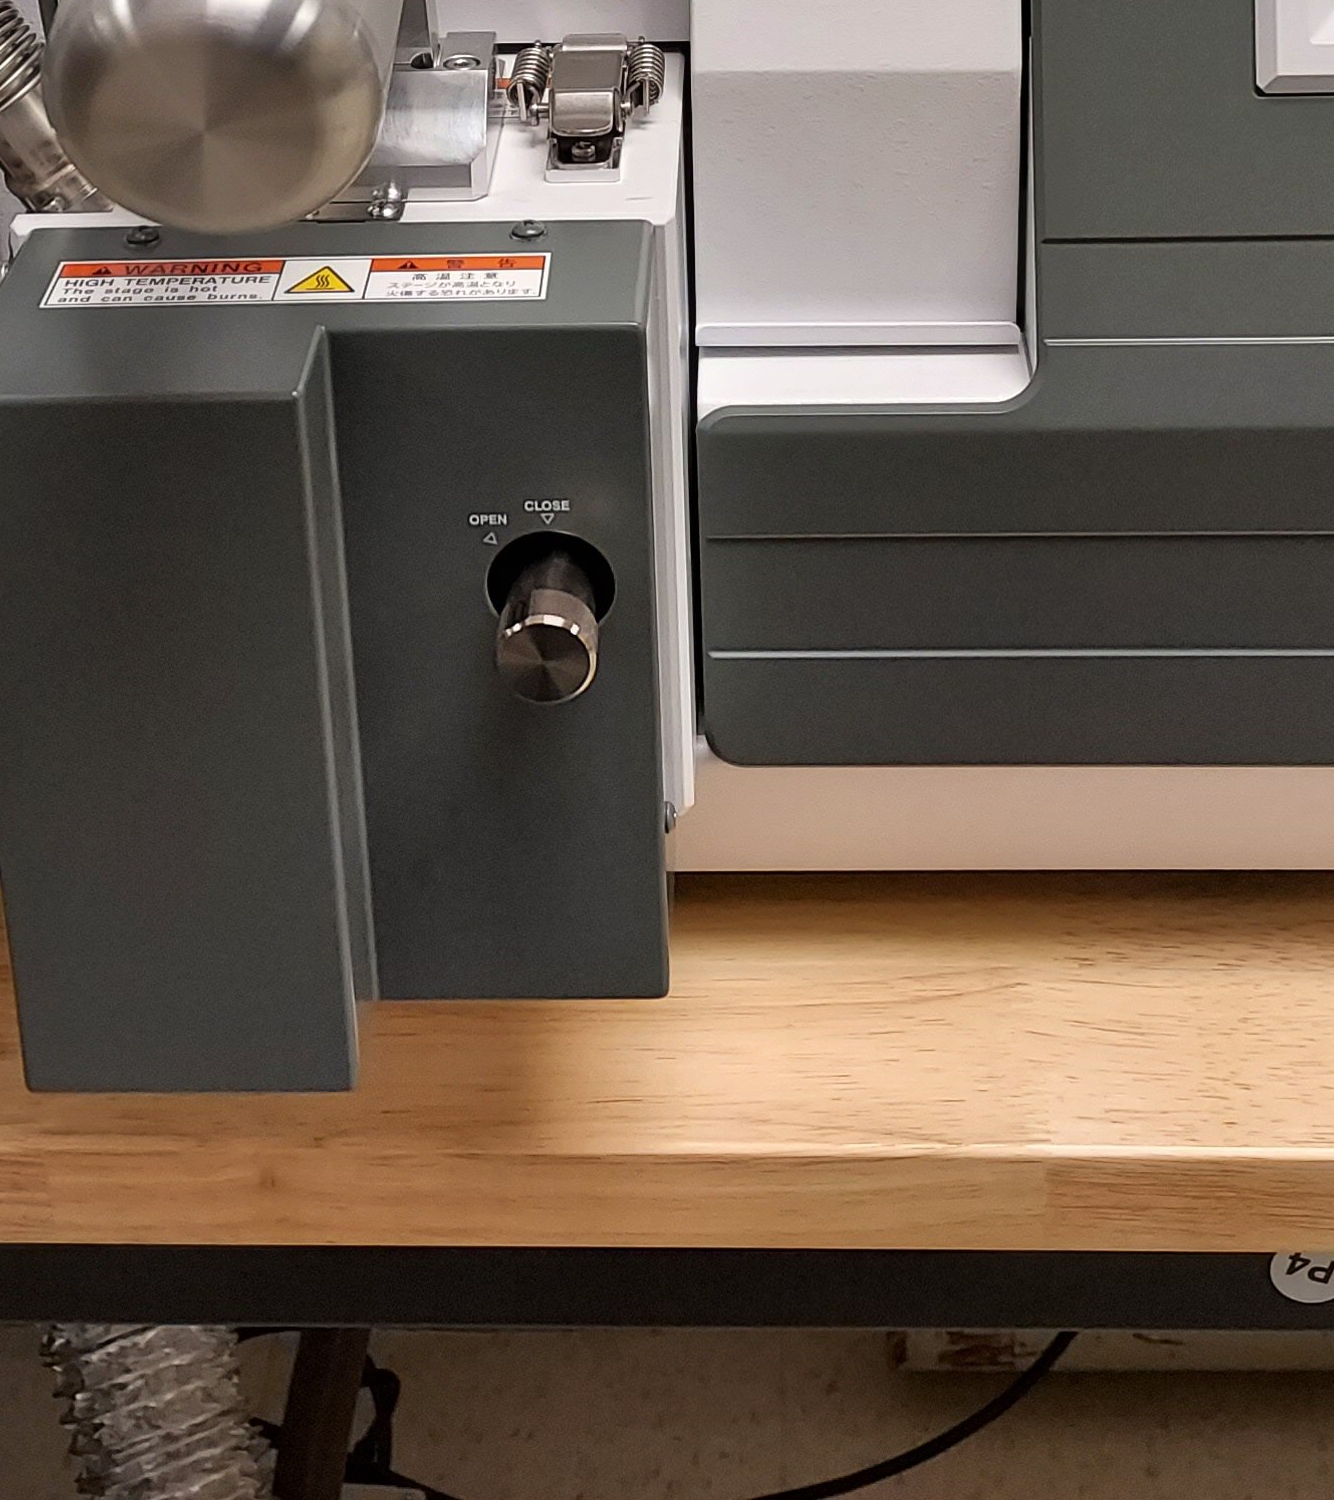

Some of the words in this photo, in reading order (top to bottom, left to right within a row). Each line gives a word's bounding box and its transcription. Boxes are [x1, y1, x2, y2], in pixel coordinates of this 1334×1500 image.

[125, 262, 263, 275] WARNING
[65, 278, 114, 287] HIGH
[124, 275, 272, 287] TEMPERATURE
[62, 287, 95, 295] The
[104, 286, 154, 295] stage
[165, 285, 179, 293] is
[189, 285, 218, 293] hot
[57, 295, 91, 303] and
[524, 500, 570, 511] CLOSE
[469, 514, 508, 526] OPEN
